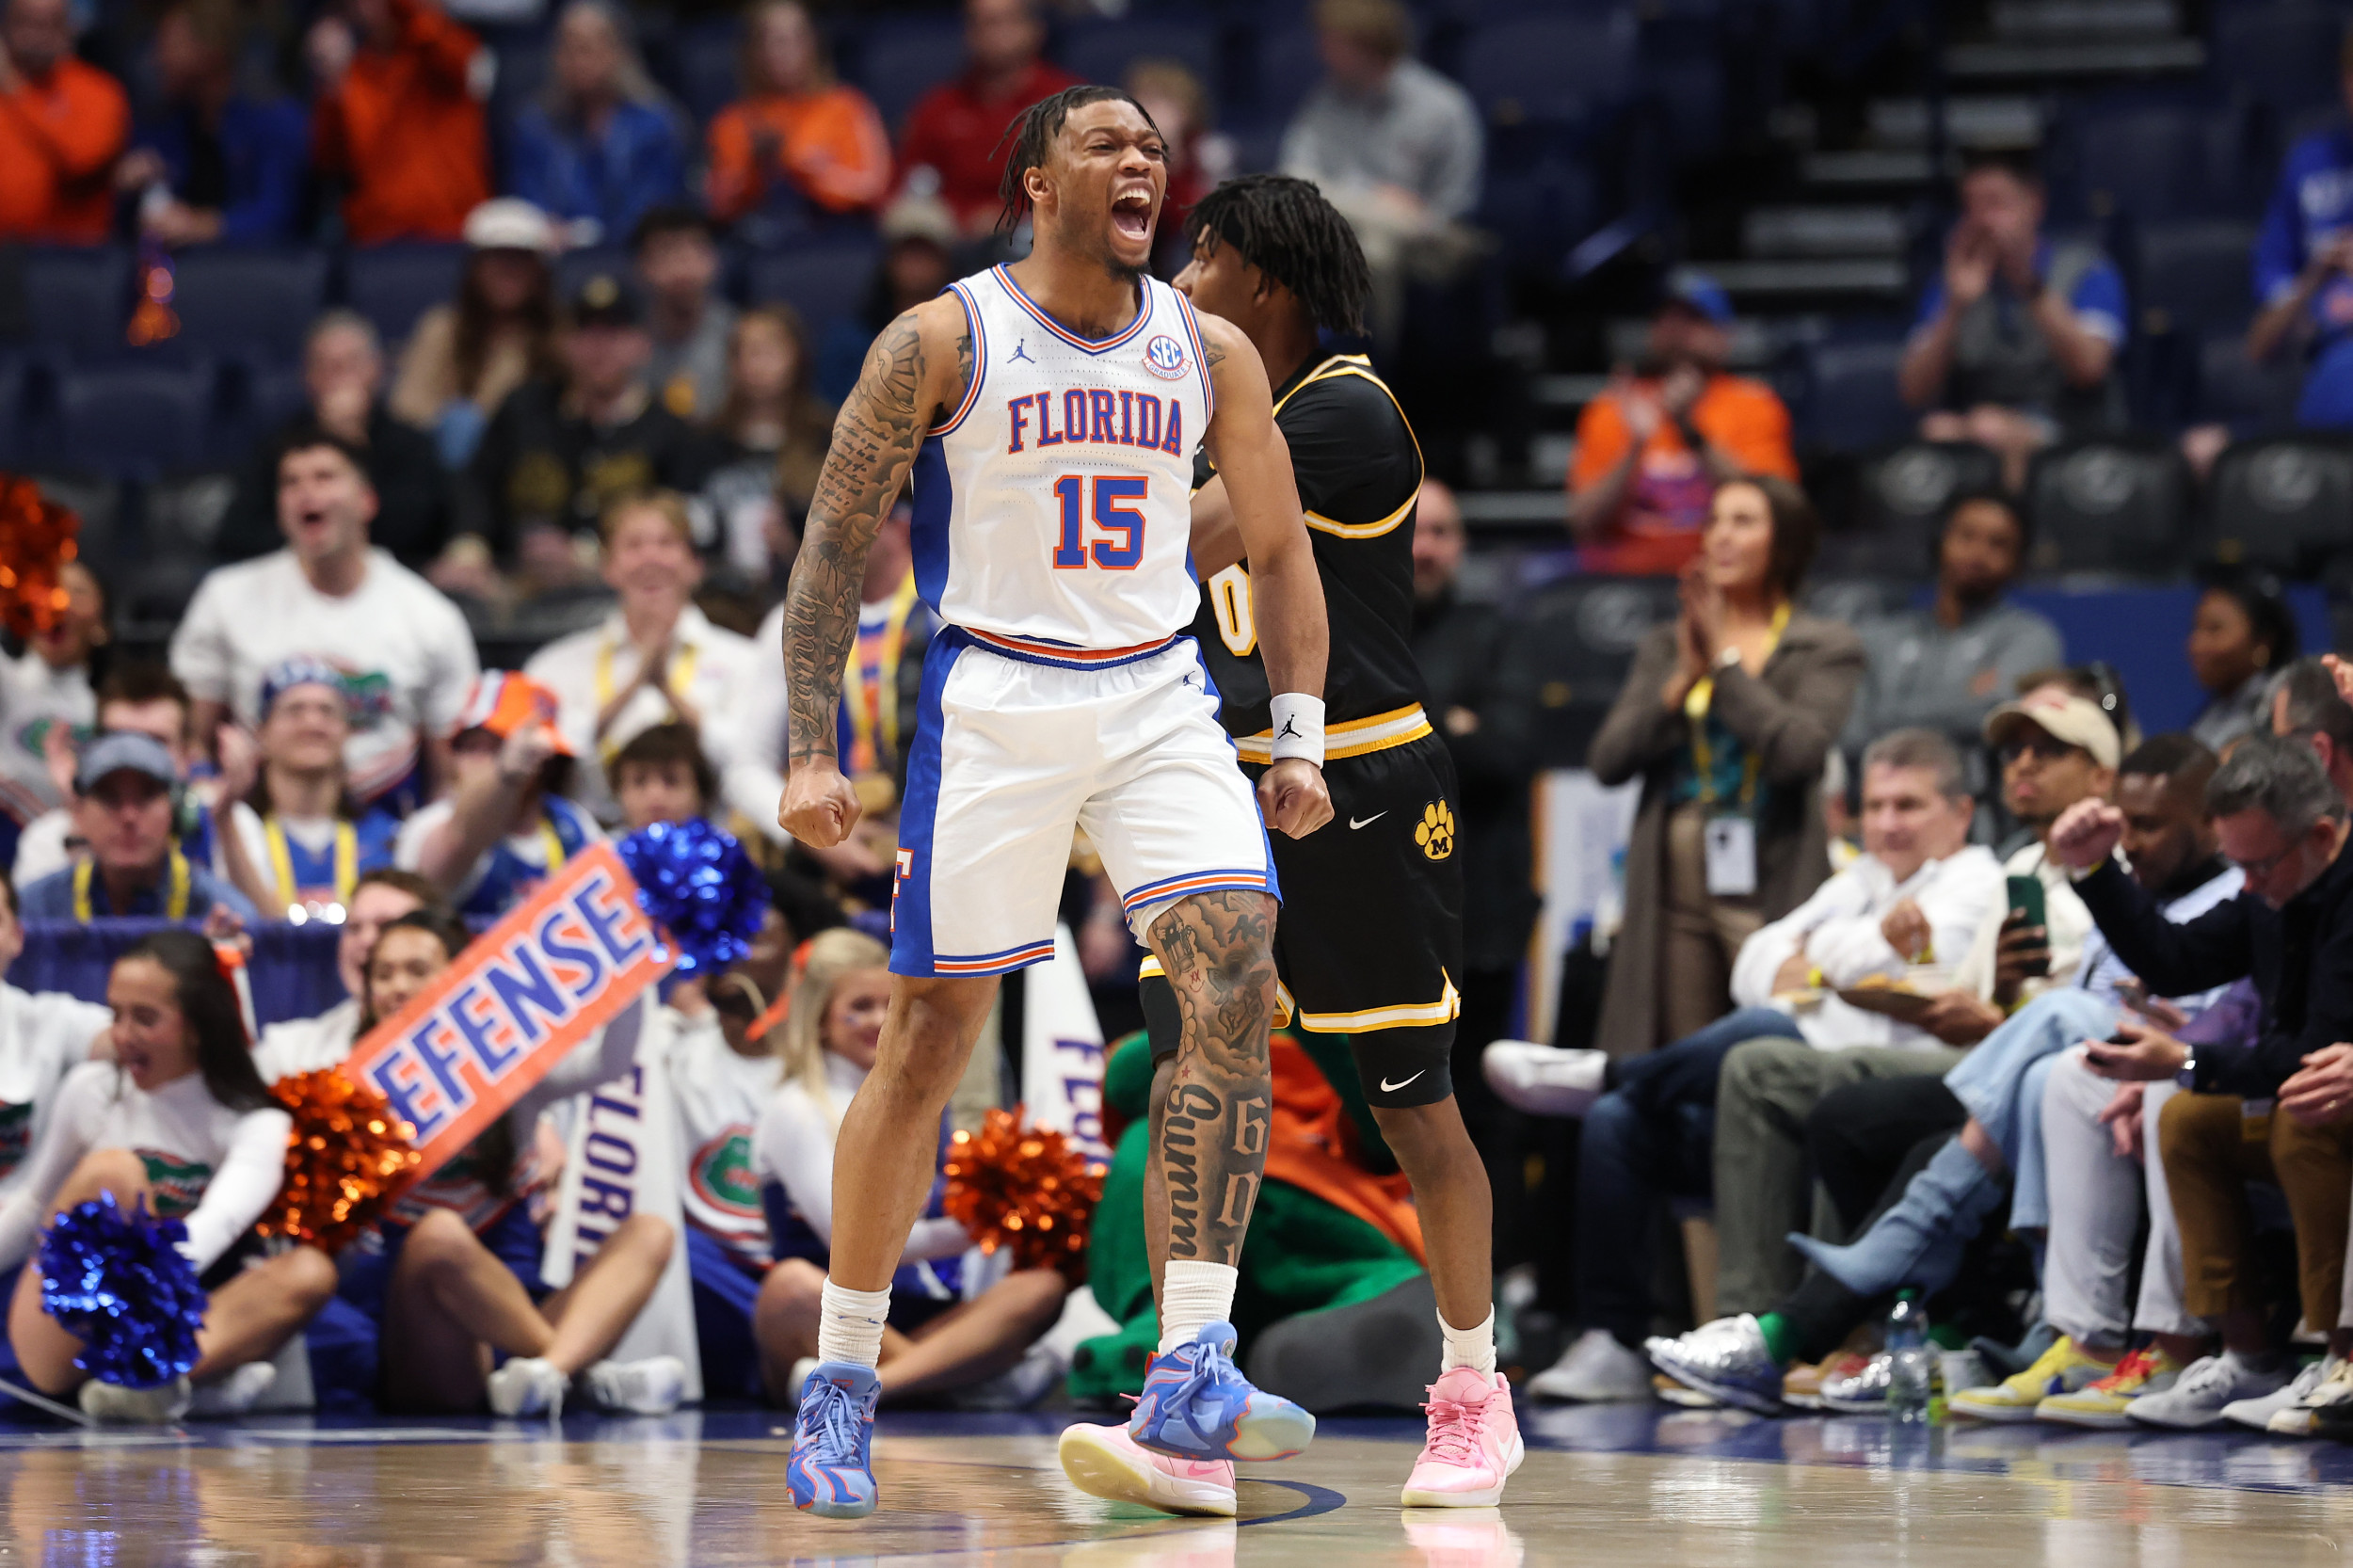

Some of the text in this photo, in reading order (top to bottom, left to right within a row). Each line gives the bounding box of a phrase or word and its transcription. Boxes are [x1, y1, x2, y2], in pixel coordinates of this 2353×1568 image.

[1148, 363, 1187, 378] GRADUATE
[1150, 336, 1182, 369] SEC
[1007, 388, 1181, 457] FLORIDA
[1052, 474, 1148, 570] 15
[1208, 563, 1257, 656] 0
[1431, 836, 1449, 856] M
[367, 872, 651, 1144] EFENSE
[576, 1065, 643, 1264] LORI
